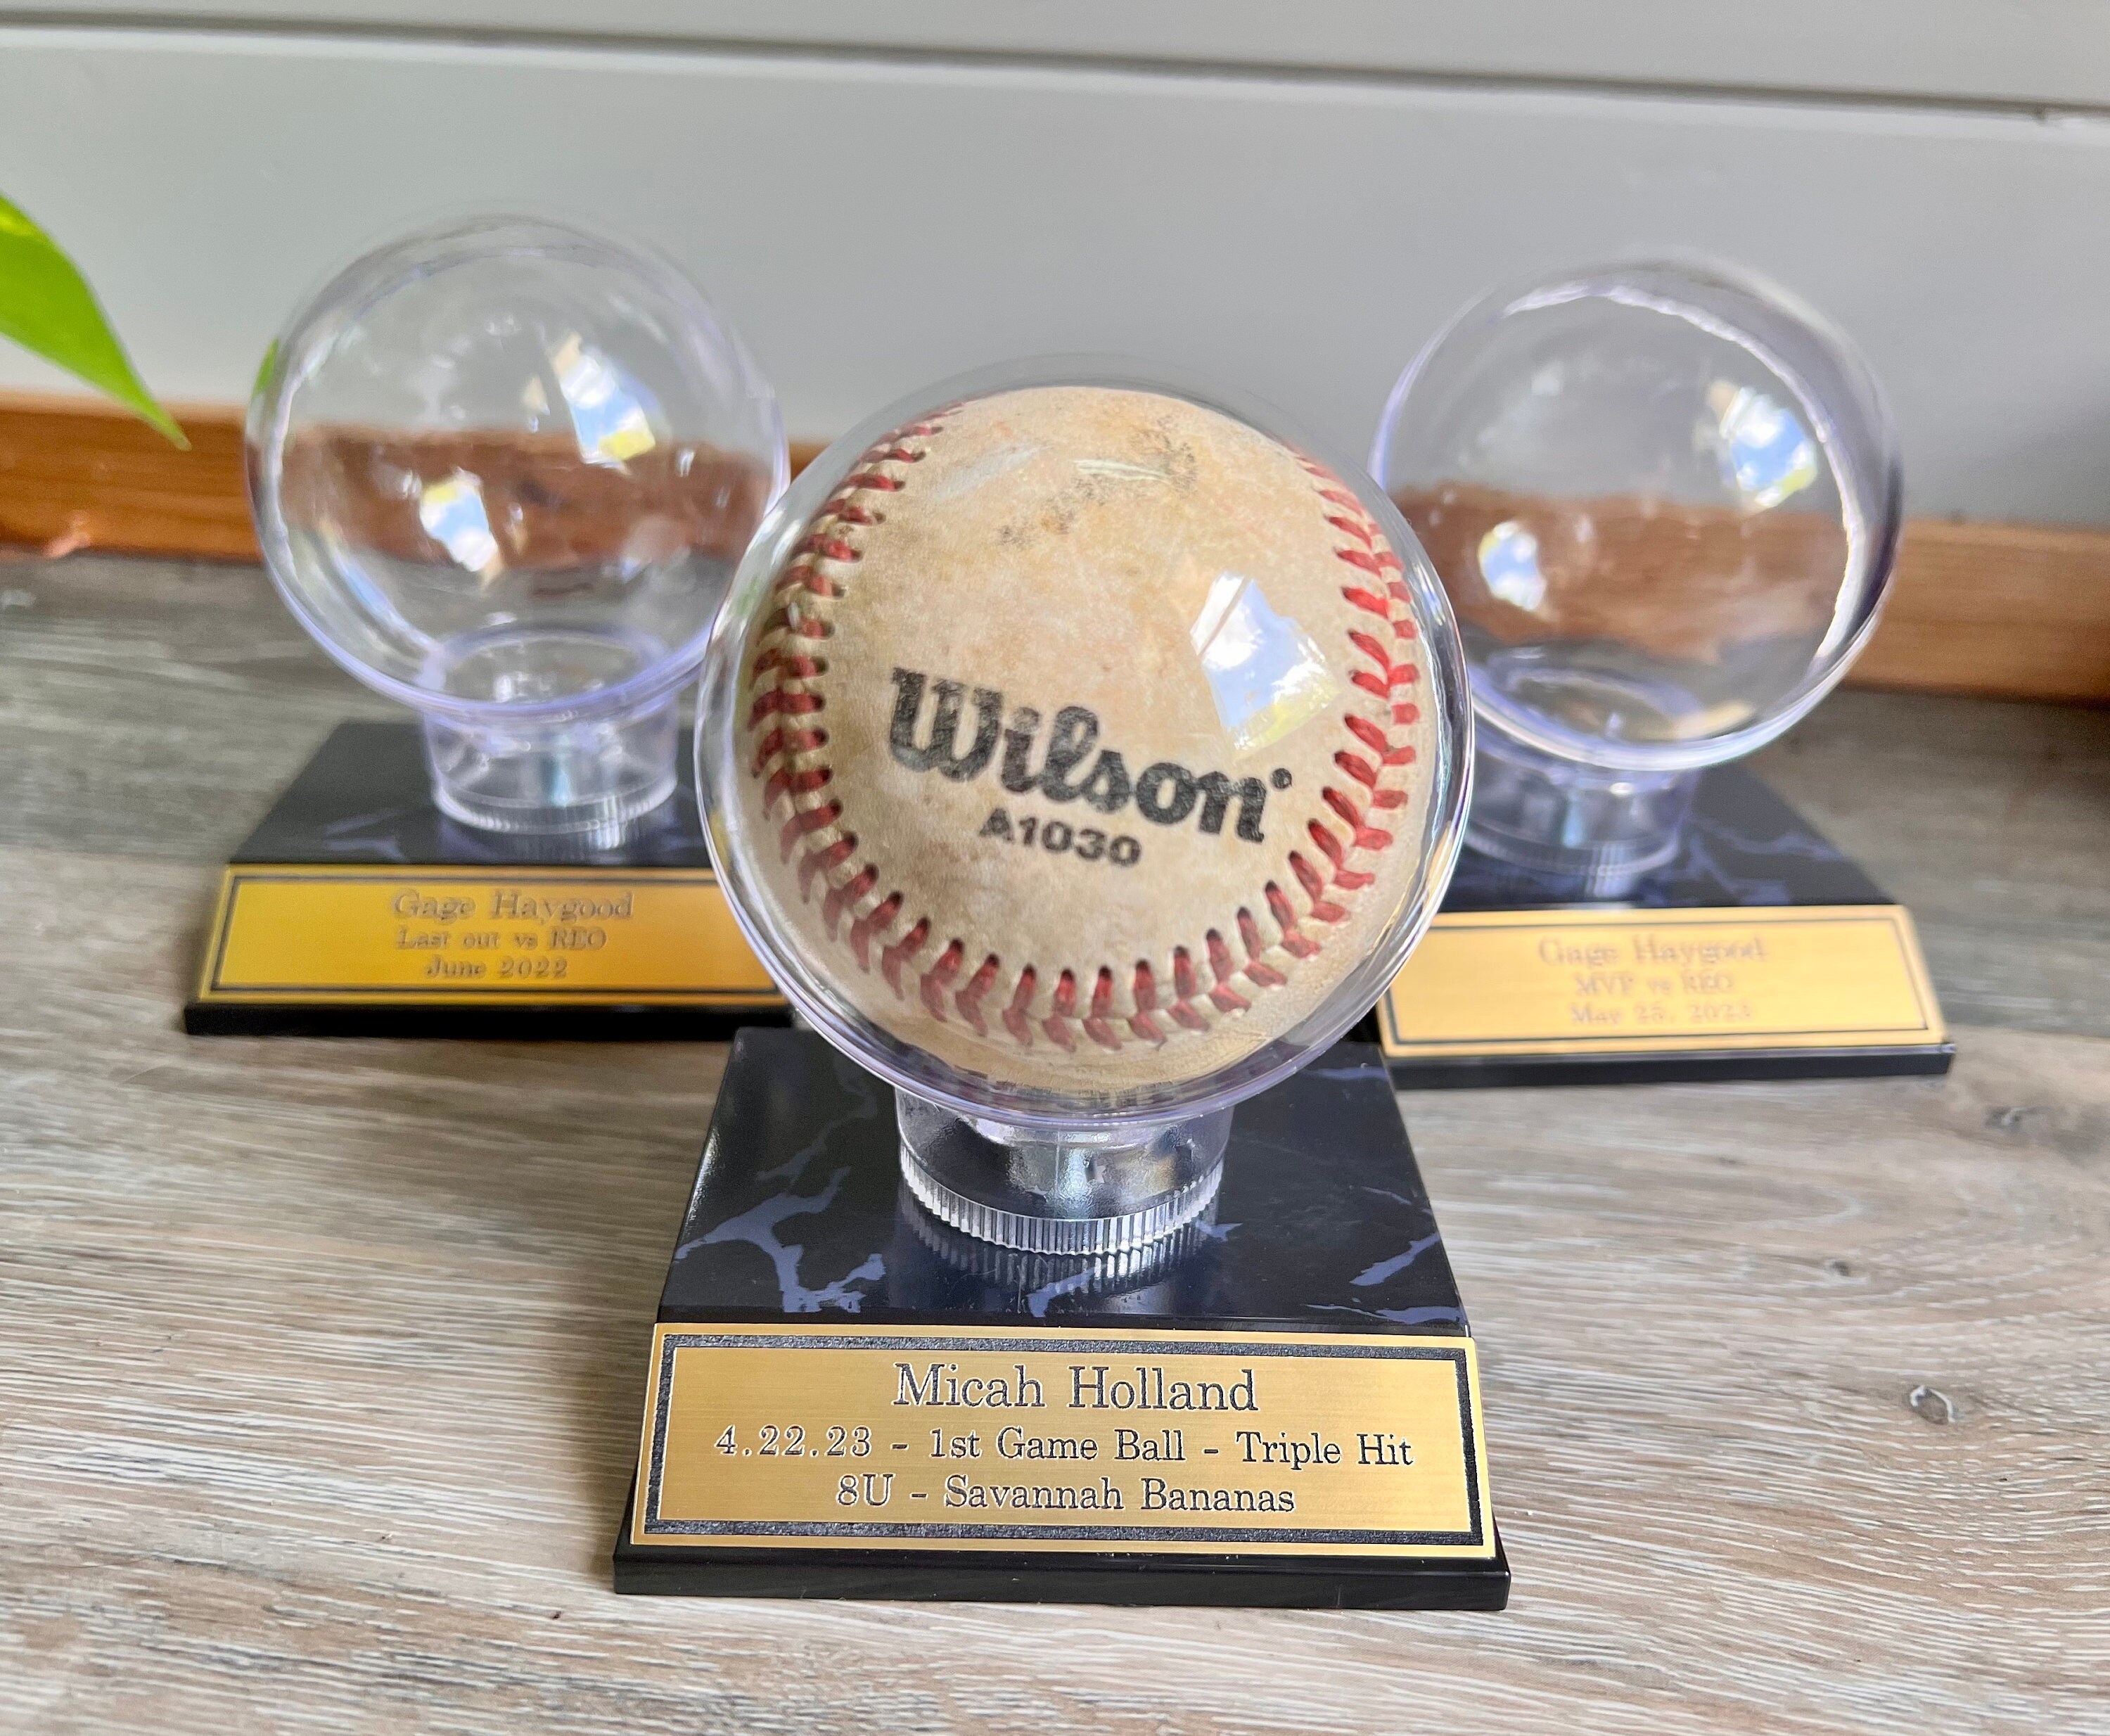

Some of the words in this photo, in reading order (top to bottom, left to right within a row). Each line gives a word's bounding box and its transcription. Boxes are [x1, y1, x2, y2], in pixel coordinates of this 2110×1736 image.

[889, 667, 1267, 843] Wilson
[980, 808, 1142, 867] A1030
[392, 888, 476, 924] Gage
[488, 889, 632, 925] Haygood
[397, 925, 450, 950] Last
[461, 930, 499, 950] out
[425, 955, 487, 979] June
[498, 956, 569, 980] 2022
[893, 1362, 1046, 1408] Micah
[1068, 1365, 1259, 1411] Holland
[714, 1425, 872, 1458] 4.22.23
[930, 1428, 983, 1460] 1st
[997, 1426, 1099, 1460] Game
[1114, 1429, 1187, 1462] Ball
[1236, 1431, 1341, 1471] Triple
[1357, 1434, 1414, 1466] Hit
[837, 1474, 894, 1507] 8U
[945, 1474, 1125, 1510] Savannah
[1140, 1478, 1296, 1512] Bananas
